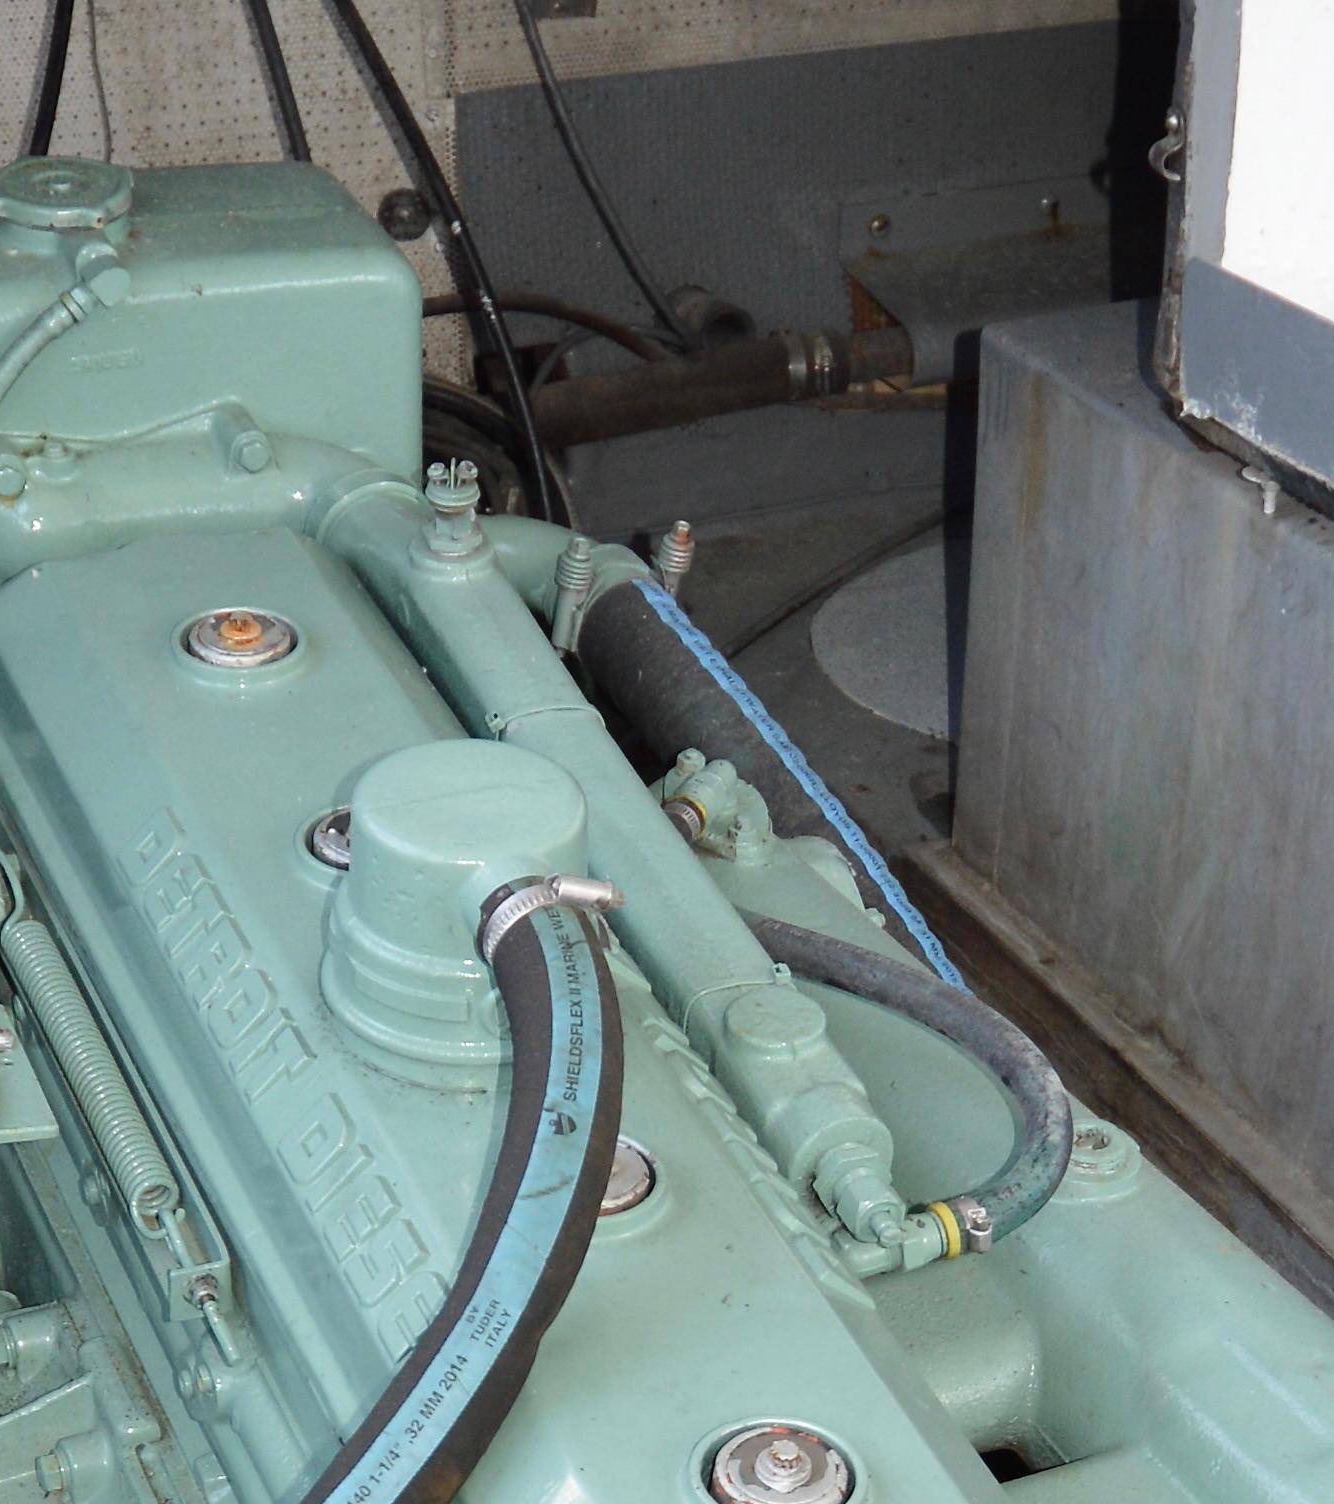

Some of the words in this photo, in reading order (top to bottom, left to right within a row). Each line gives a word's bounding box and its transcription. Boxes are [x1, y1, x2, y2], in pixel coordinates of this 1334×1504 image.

[117, 805, 318, 1104] DETROIT
[558, 933, 582, 986] MARINE
[563, 999, 584, 1102] SHIELDSFLEX
[466, 1304, 481, 1324] BY
[470, 1299, 500, 1342] TUDER
[484, 1310, 512, 1348] ITALY
[419, 1391, 445, 1421] MM
[438, 1354, 469, 1392] 2014
